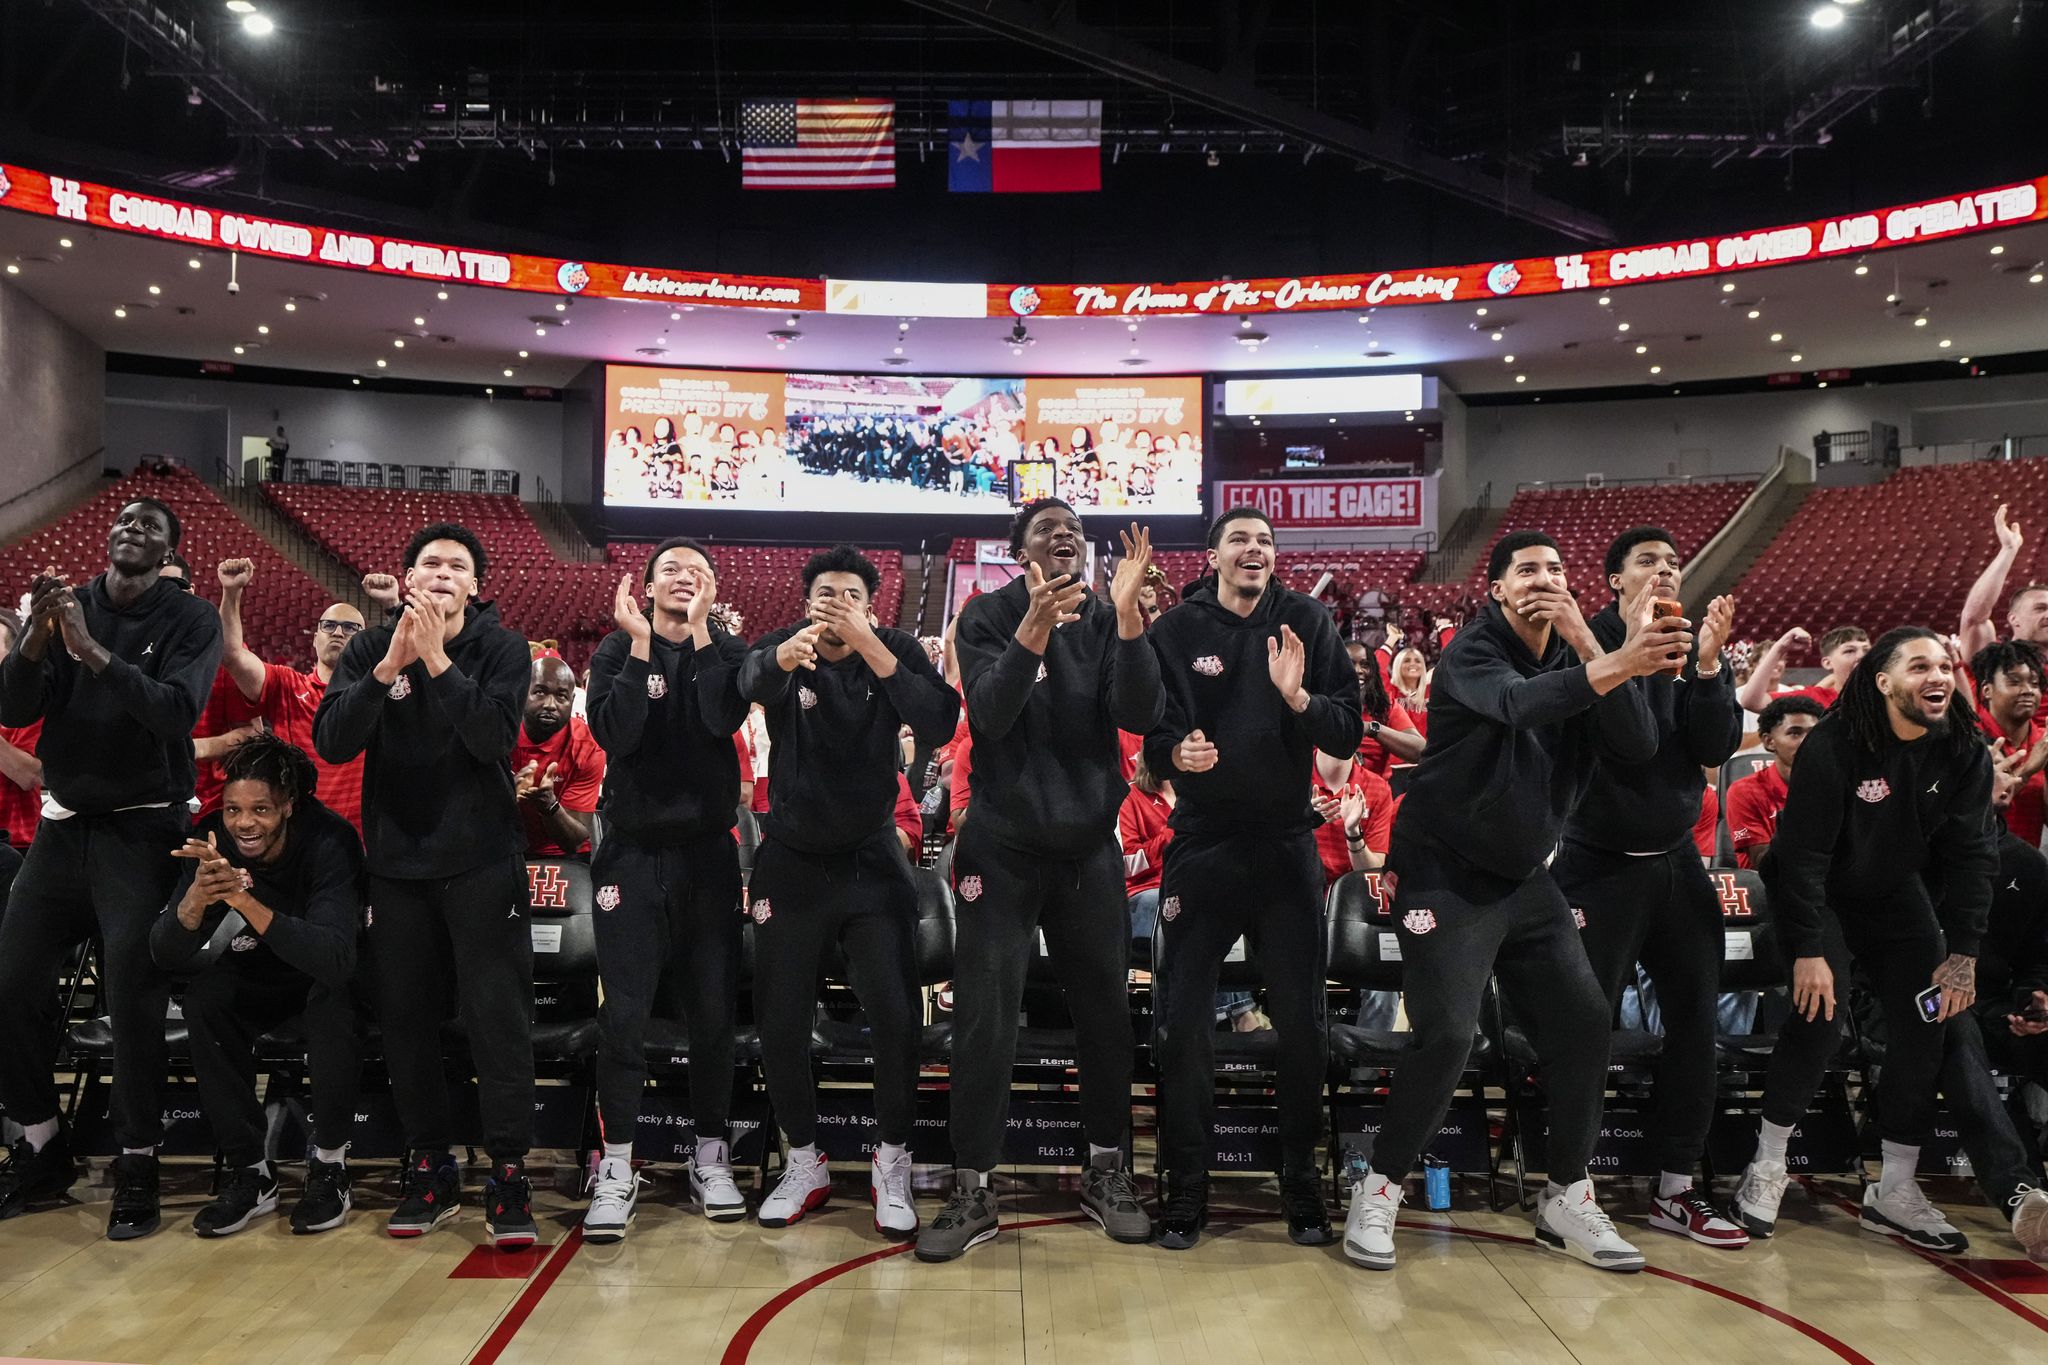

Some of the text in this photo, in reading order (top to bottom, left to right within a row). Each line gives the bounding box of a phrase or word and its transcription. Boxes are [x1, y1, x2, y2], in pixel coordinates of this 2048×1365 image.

[51, 176, 511, 284] UH COUGAR OWNED AND OPERATED
[1555, 184, 2037, 289] UH COUGAR OWNED AND OPERATED
[1073, 286, 1118, 315] The
[1122, 285, 1188, 314] Home
[1193, 286, 1220, 311] of
[1365, 273, 1460, 305] Cooking
[619, 398, 749, 418] PRESENTED BY
[1138, 408, 1164, 424] BY
[1229, 484, 1416, 520] FEAR THE CAGE!
[1040, 1058, 1075, 1066] FL6:1:2
[1224, 1063, 1257, 1071] FL6:1:1
[172, 1109, 200, 1119] Cook
[637, 1115, 663, 1127] ecky
[665, 1115, 673, 1125] &
[850, 1115, 858, 1125] &
[912, 1119, 948, 1128] rmour
[1025, 1118, 1034, 1128] &
[1036, 1118, 1081, 1130] Spencer
[1213, 1123, 1259, 1135] Spencer
[1438, 1125, 1463, 1135] ook
[1613, 1128, 1644, 1138] Cook
[1038, 1146, 1075, 1157] FL6:1:2
[1217, 1151, 1252, 1162] FL6:1:1
[1588, 1155, 1619, 1166] :1:10
